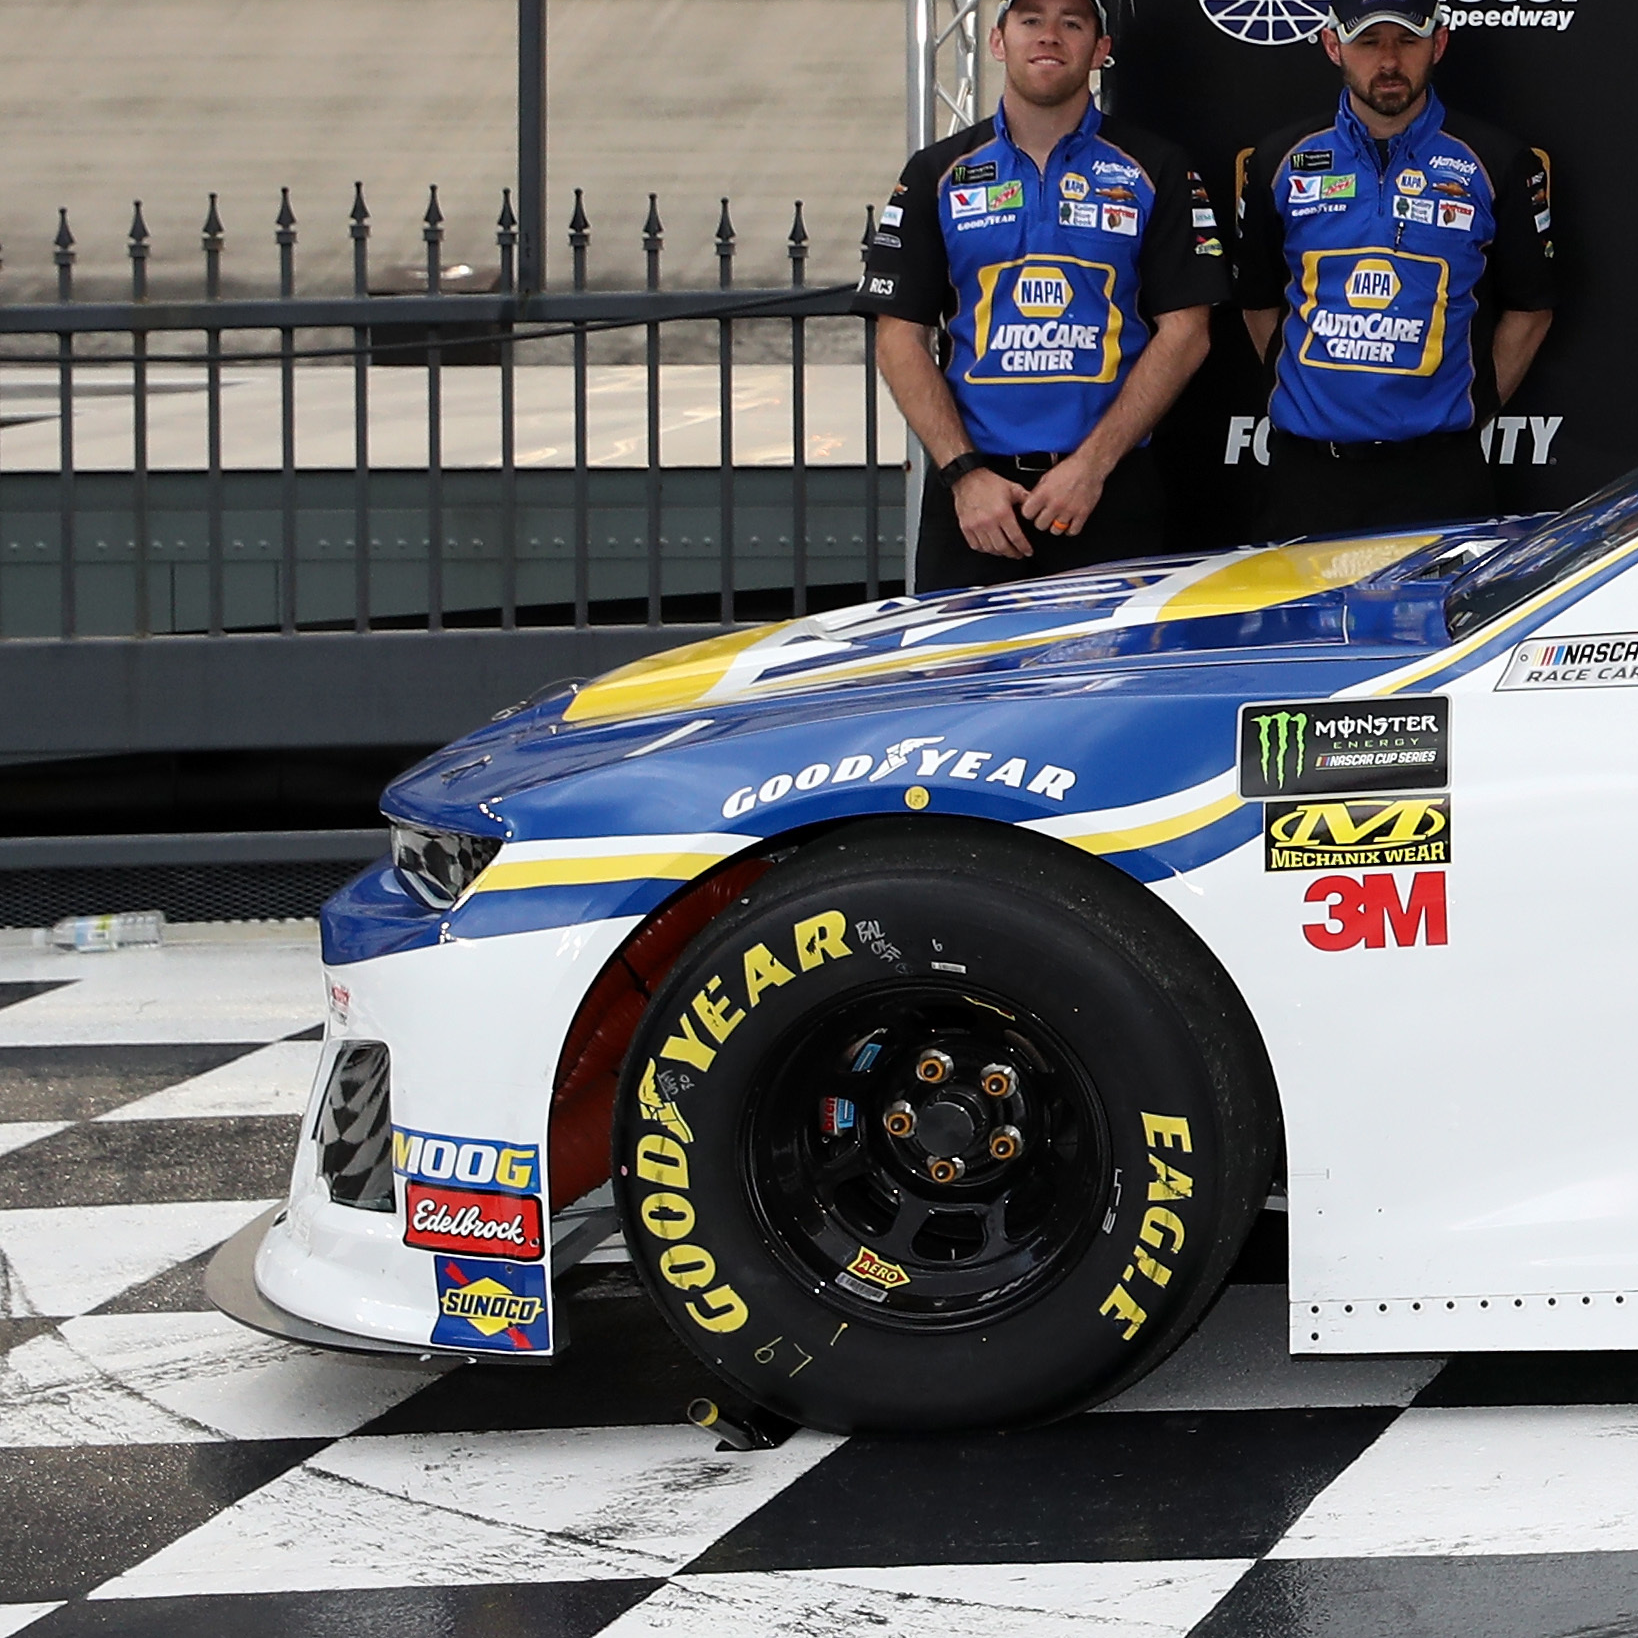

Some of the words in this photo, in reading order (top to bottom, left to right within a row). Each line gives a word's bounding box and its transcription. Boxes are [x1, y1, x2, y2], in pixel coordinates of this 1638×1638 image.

[869, 277, 894, 295] RC3
[1020, 279, 1066, 305] NAPA
[1352, 271, 1391, 297] NAPA
[1001, 349, 1074, 372] CENTER
[1326, 338, 1396, 363] CENTER
[1526, 668, 1593, 684] RACE
[1314, 712, 1440, 740] MONSTER
[1332, 737, 1421, 750] ENERGY
[1329, 752, 1375, 768] NASCAR
[1375, 751, 1398, 767] CUP
[1398, 750, 1437, 766] SERIES
[720, 736, 1078, 822] GOODYEAR
[1270, 847, 1381, 870] MECHANIX
[1383, 842, 1447, 864] WEAR
[1301, 871, 1450, 953] 3M
[634, 907, 856, 1337] GOODYEAR
[392, 1130, 536, 1190] MOOG
[412, 1198, 526, 1245] Edelbrock
[1097, 1110, 1193, 1344] EAGLE
[859, 1258, 900, 1284] AERO
[445, 1290, 540, 1324] SUNOCO
